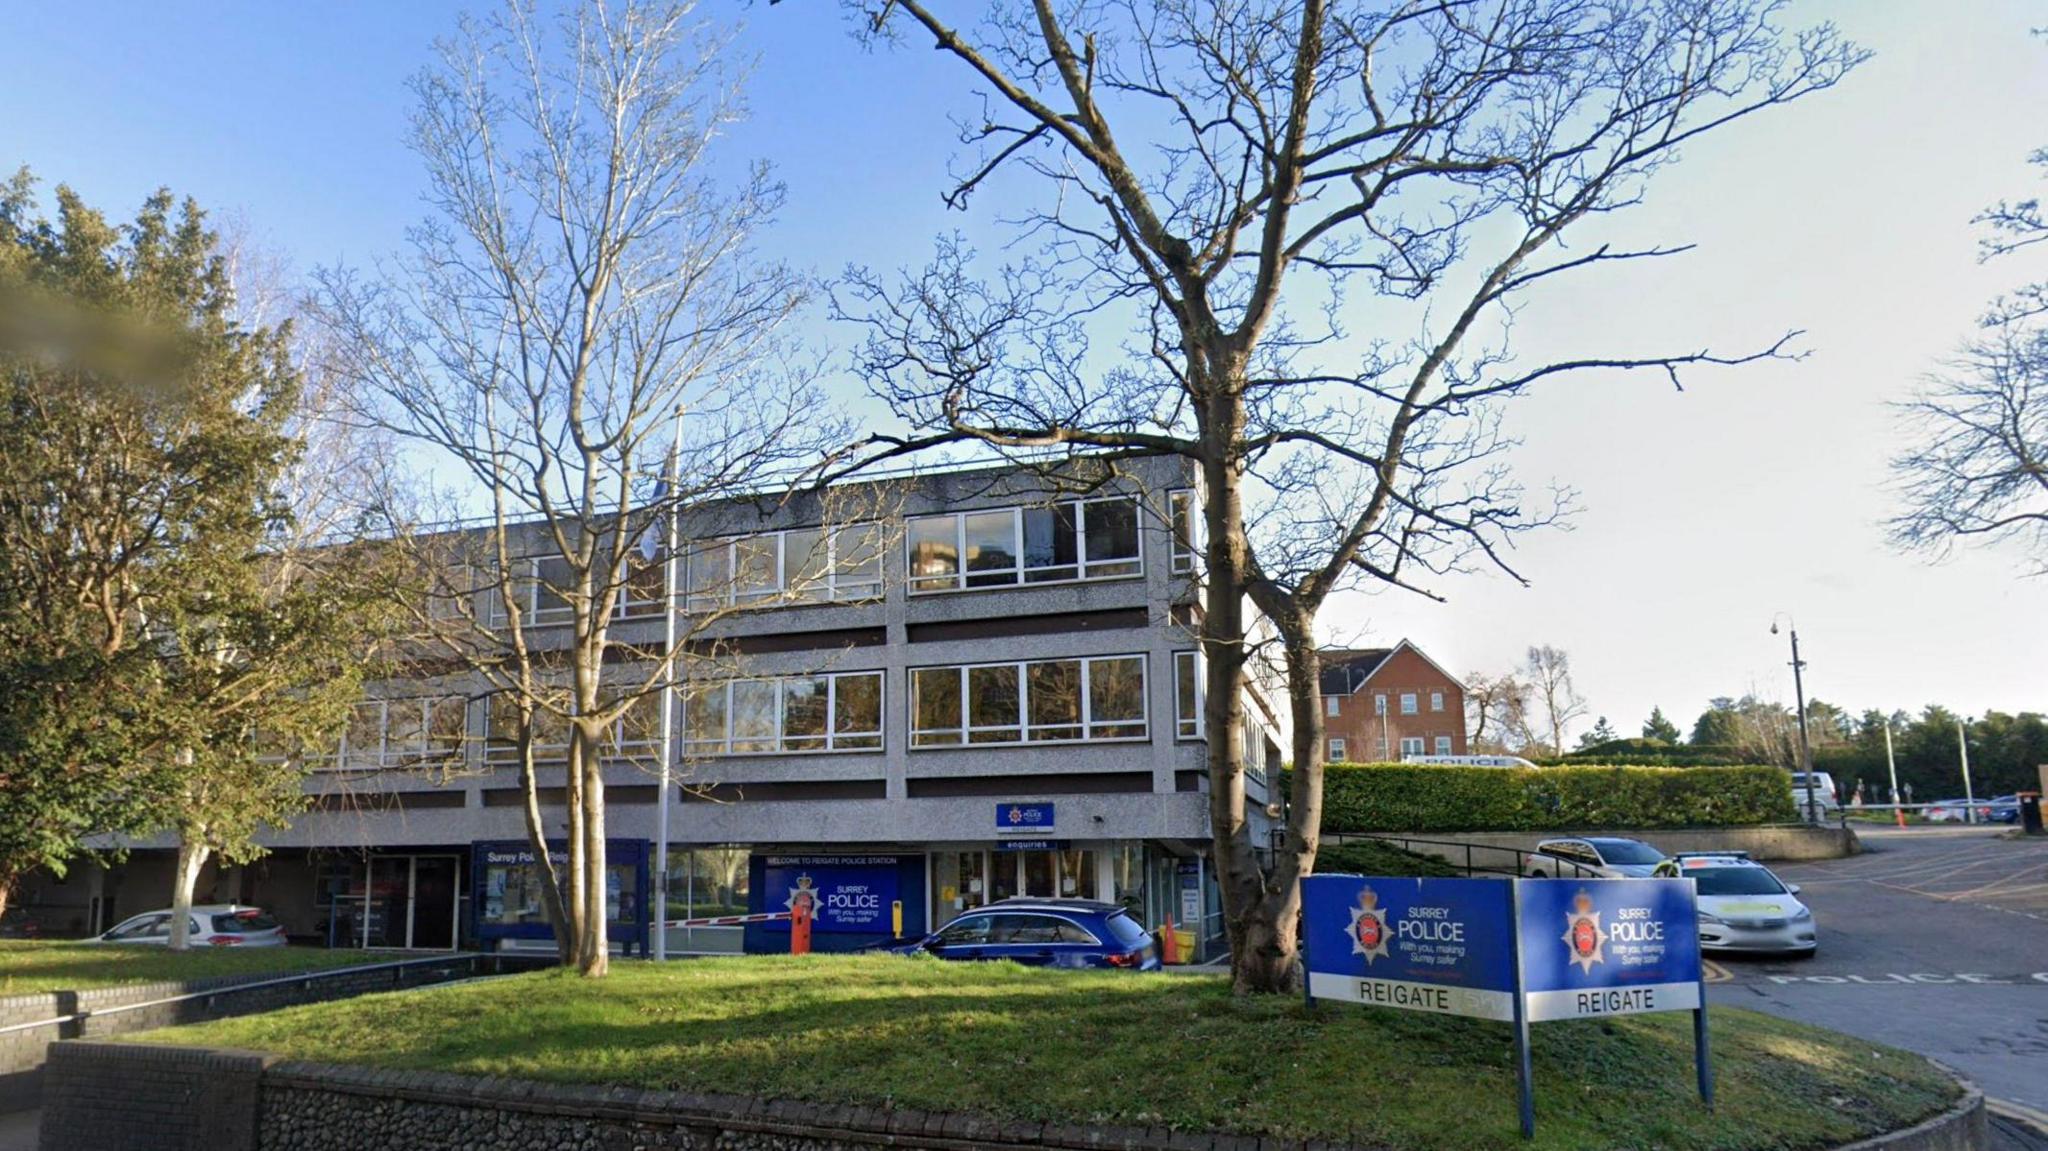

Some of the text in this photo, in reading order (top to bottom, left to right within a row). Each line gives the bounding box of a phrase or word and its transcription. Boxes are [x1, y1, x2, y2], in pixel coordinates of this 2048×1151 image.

[1426, 759, 1505, 767] POLICE
[1008, 841, 1048, 849] enquiries
[487, 851, 517, 864] Surrey
[836, 885, 869, 894] SURREY
[828, 894, 879, 908] POLICE
[856, 909, 879, 918] making
[1408, 906, 1449, 919] SURREY
[1618, 908, 1652, 920] SURREY
[836, 915, 855, 924] Surrey
[1398, 920, 1465, 942] POLICE
[1610, 921, 1664, 942] POLICE
[1400, 941, 1416, 951] With
[1436, 945, 1465, 957] making
[1411, 952, 1457, 965] Surrey safer
[1622, 954, 1642, 966] Surrey
[1767, 972, 2013, 985] POLICE
[1360, 981, 1449, 1009] REIGATE
[1578, 989, 1654, 1014] REIGATE
